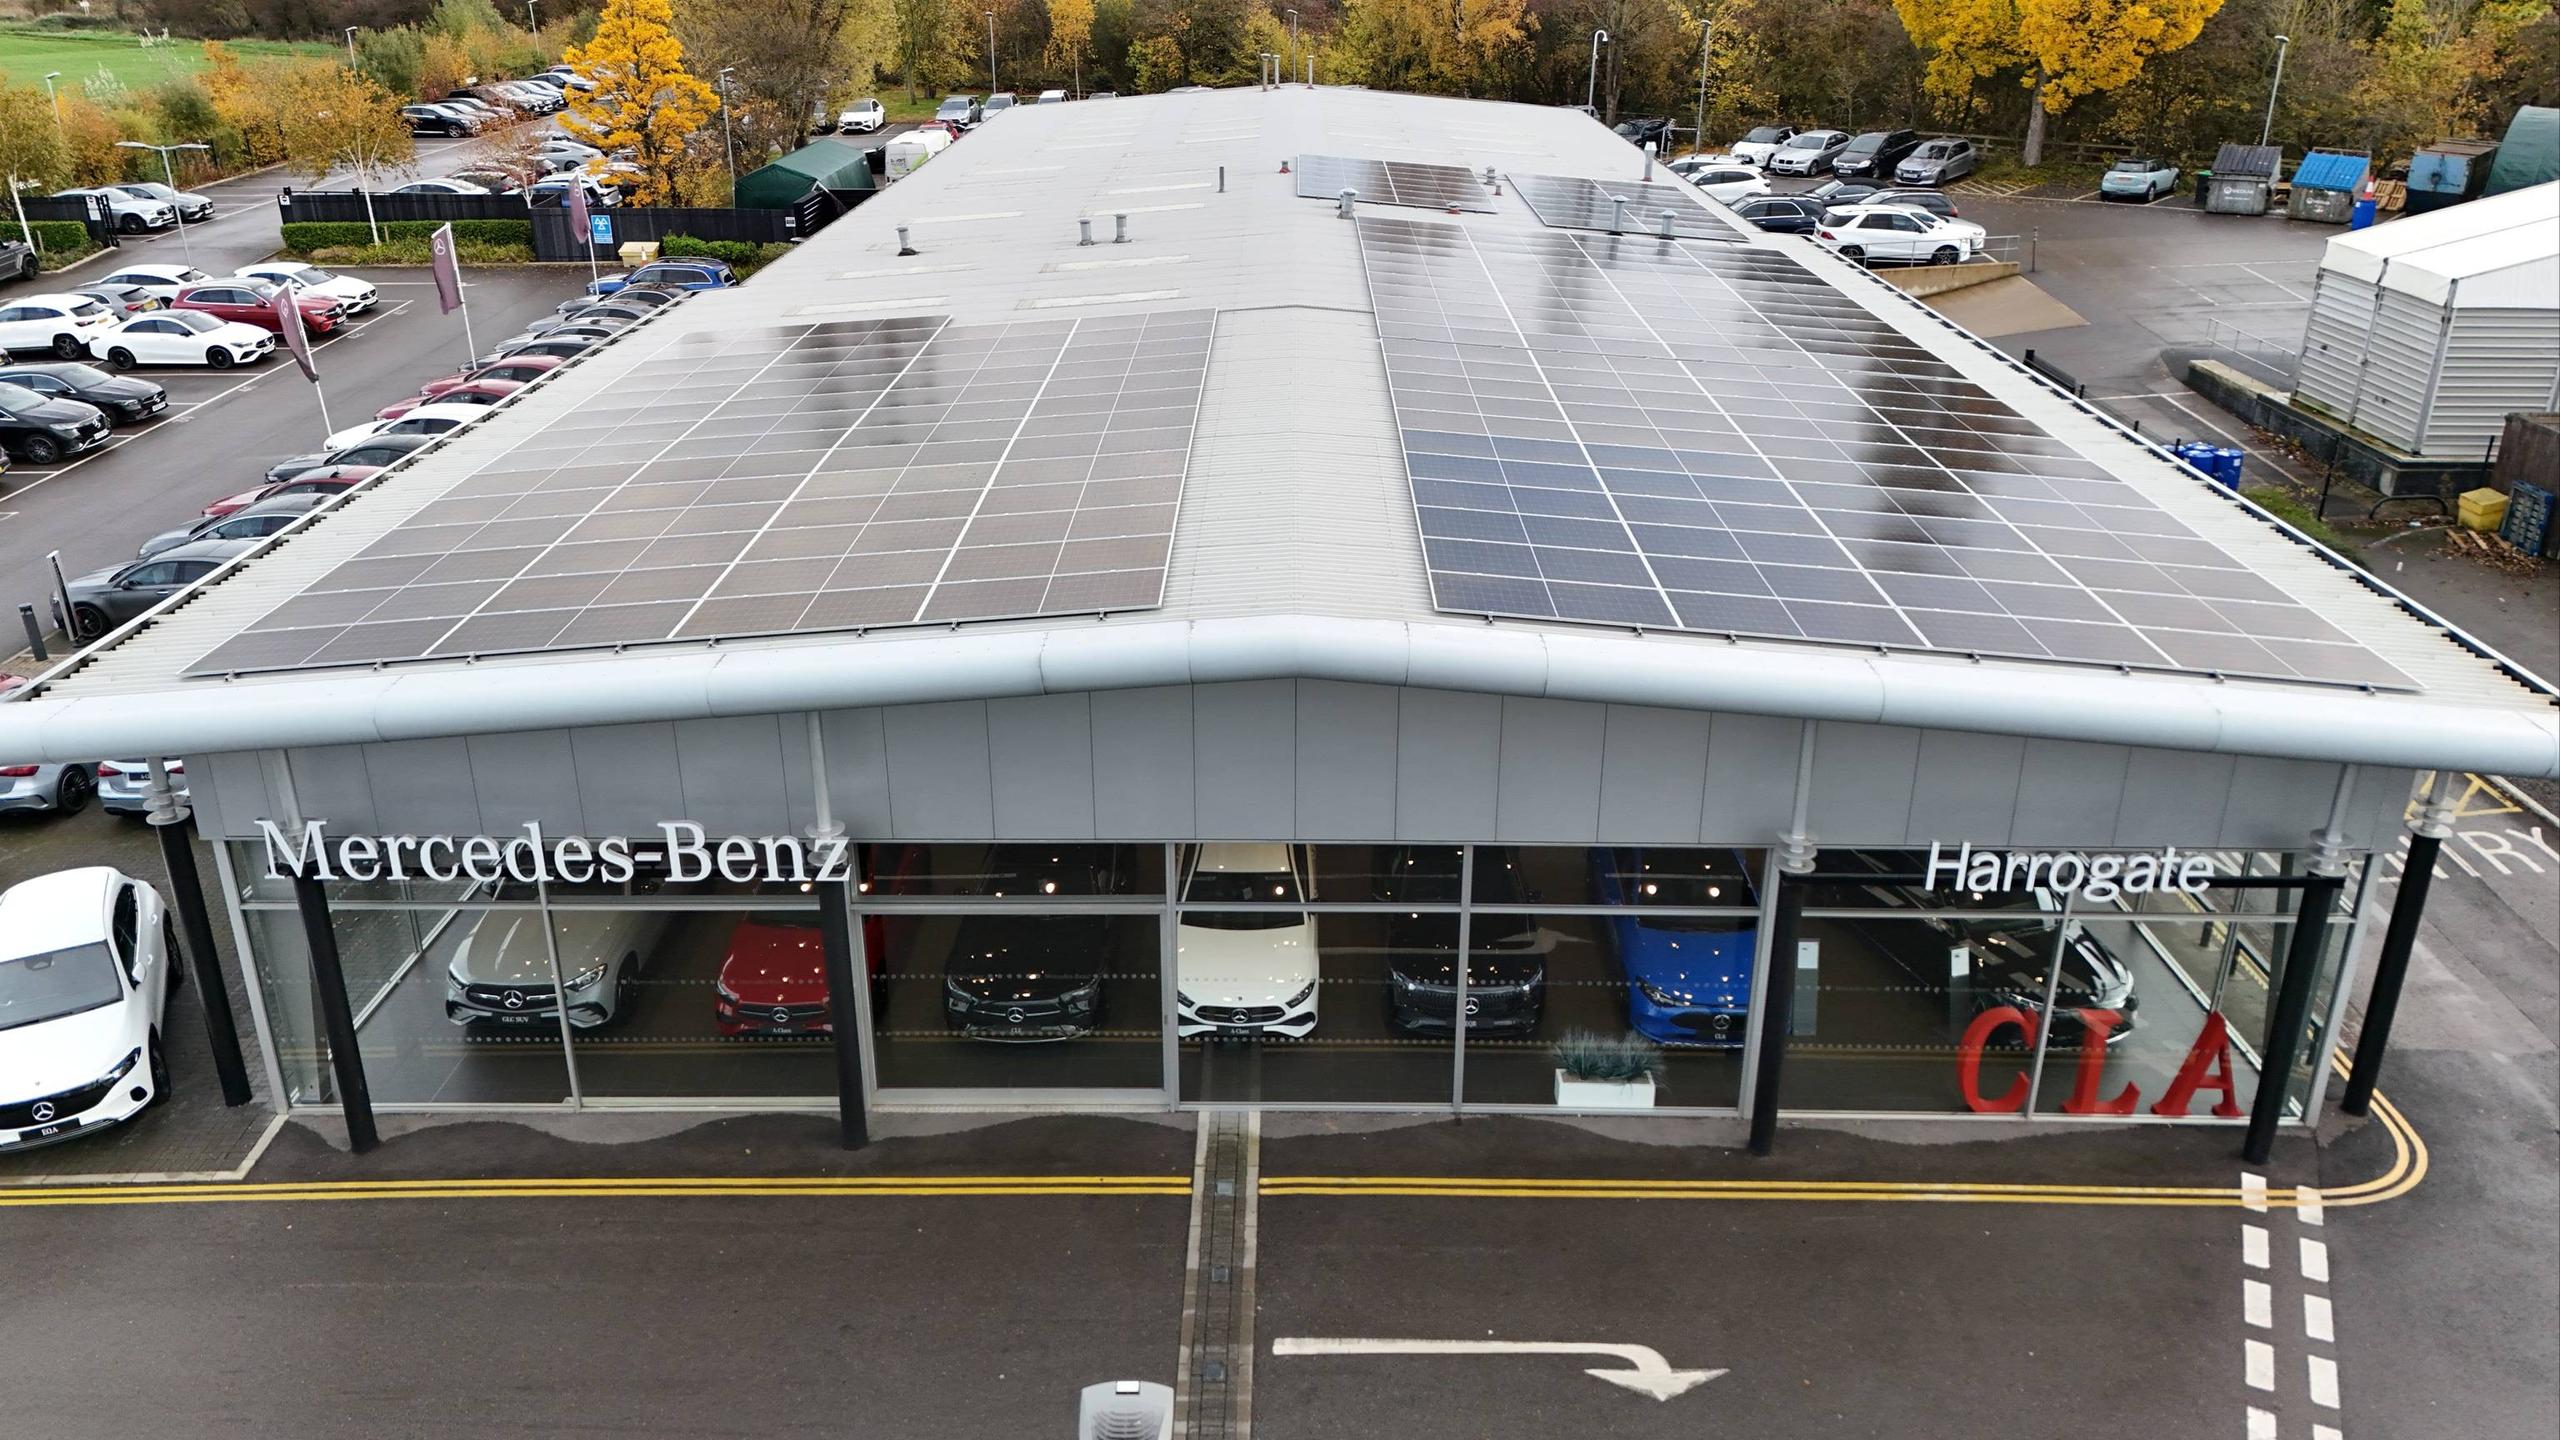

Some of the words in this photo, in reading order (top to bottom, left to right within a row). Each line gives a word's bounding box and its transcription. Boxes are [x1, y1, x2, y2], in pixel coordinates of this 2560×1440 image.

[254, 818, 851, 883] Mercedes-Benz
[1924, 841, 2215, 901] Harrogate
[1956, 1005, 2245, 1117] CLA
